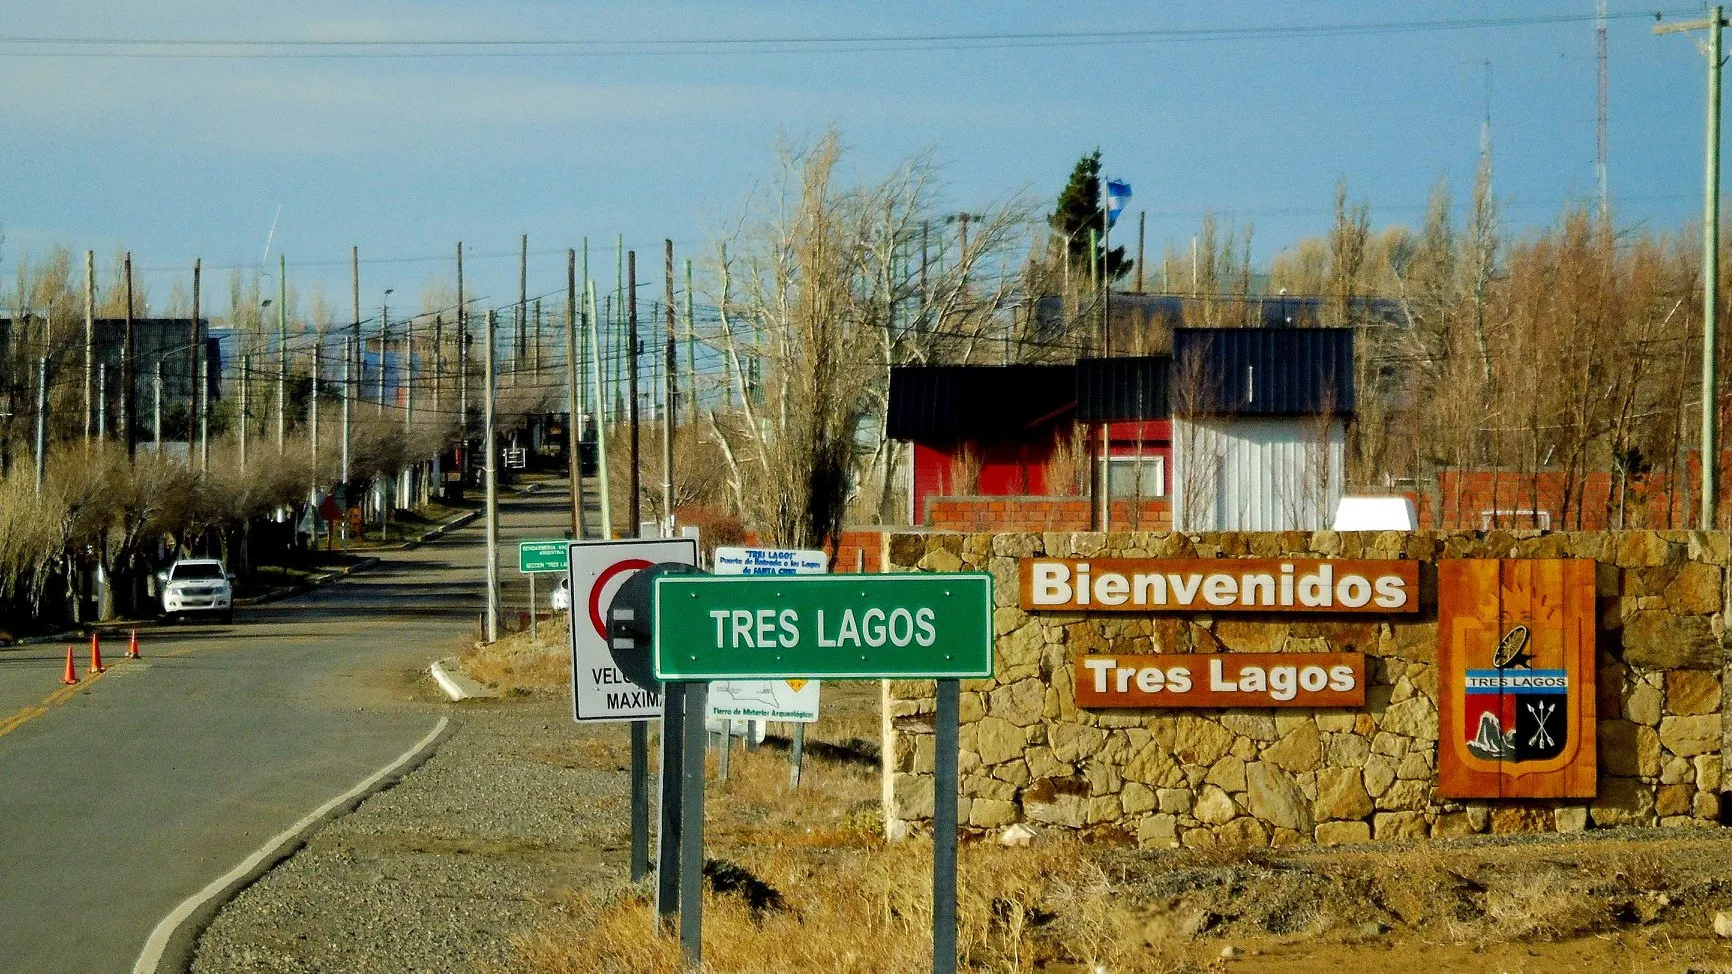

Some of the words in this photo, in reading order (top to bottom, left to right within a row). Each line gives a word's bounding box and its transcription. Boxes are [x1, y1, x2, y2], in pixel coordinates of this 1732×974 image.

[1032, 563, 1408, 608] Bienvenidos
[710, 609, 800, 648] TRES
[817, 608, 936, 647] LAGOS
[1084, 659, 1193, 693] Tres
[1208, 659, 1356, 700] Lagos
[1470, 678, 1508, 687] TRES
[1513, 678, 1566, 687] LAGOS
[607, 691, 662, 710] MAXIM
